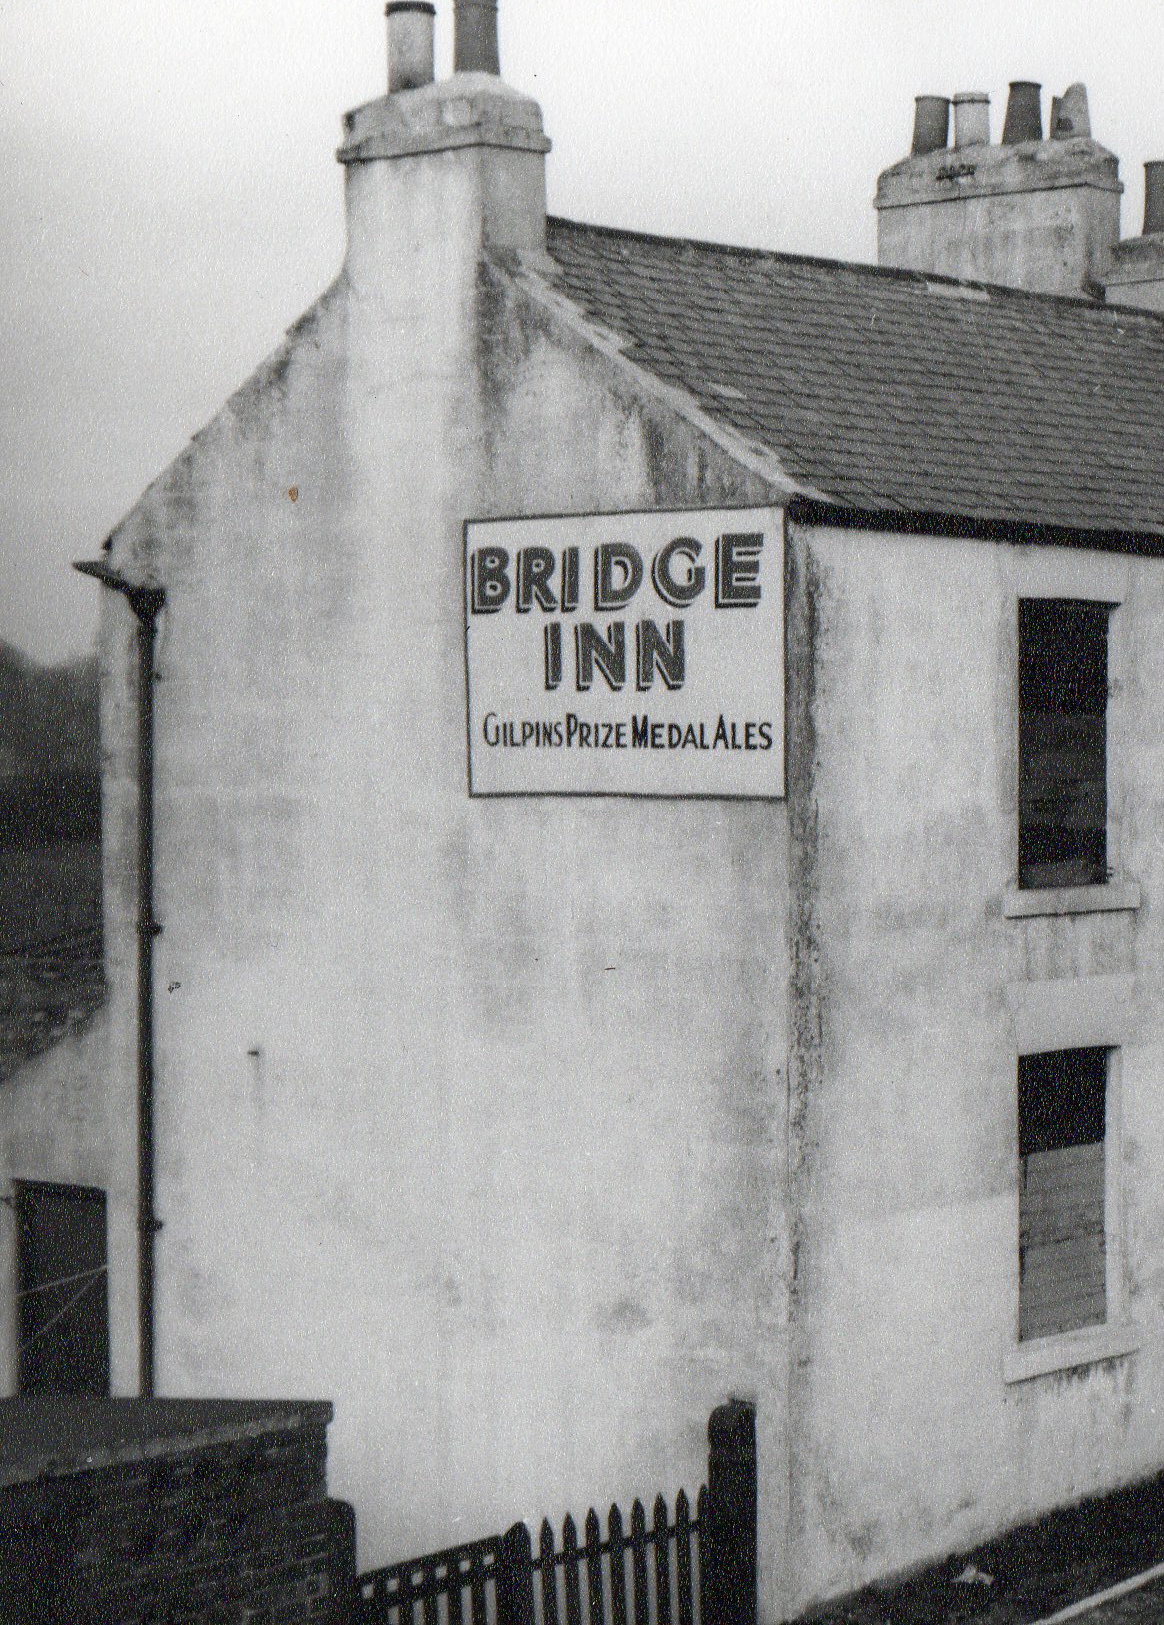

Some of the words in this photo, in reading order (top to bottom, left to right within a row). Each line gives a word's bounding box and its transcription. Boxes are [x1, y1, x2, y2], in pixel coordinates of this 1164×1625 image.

[471, 533, 764, 614] BRIDGE
[544, 619, 686, 692] INN
[483, 712, 563, 748] GILPINS
[566, 713, 628, 749] PRIZE
[631, 714, 710, 750] MEDAL
[712, 714, 773, 750] ALES
